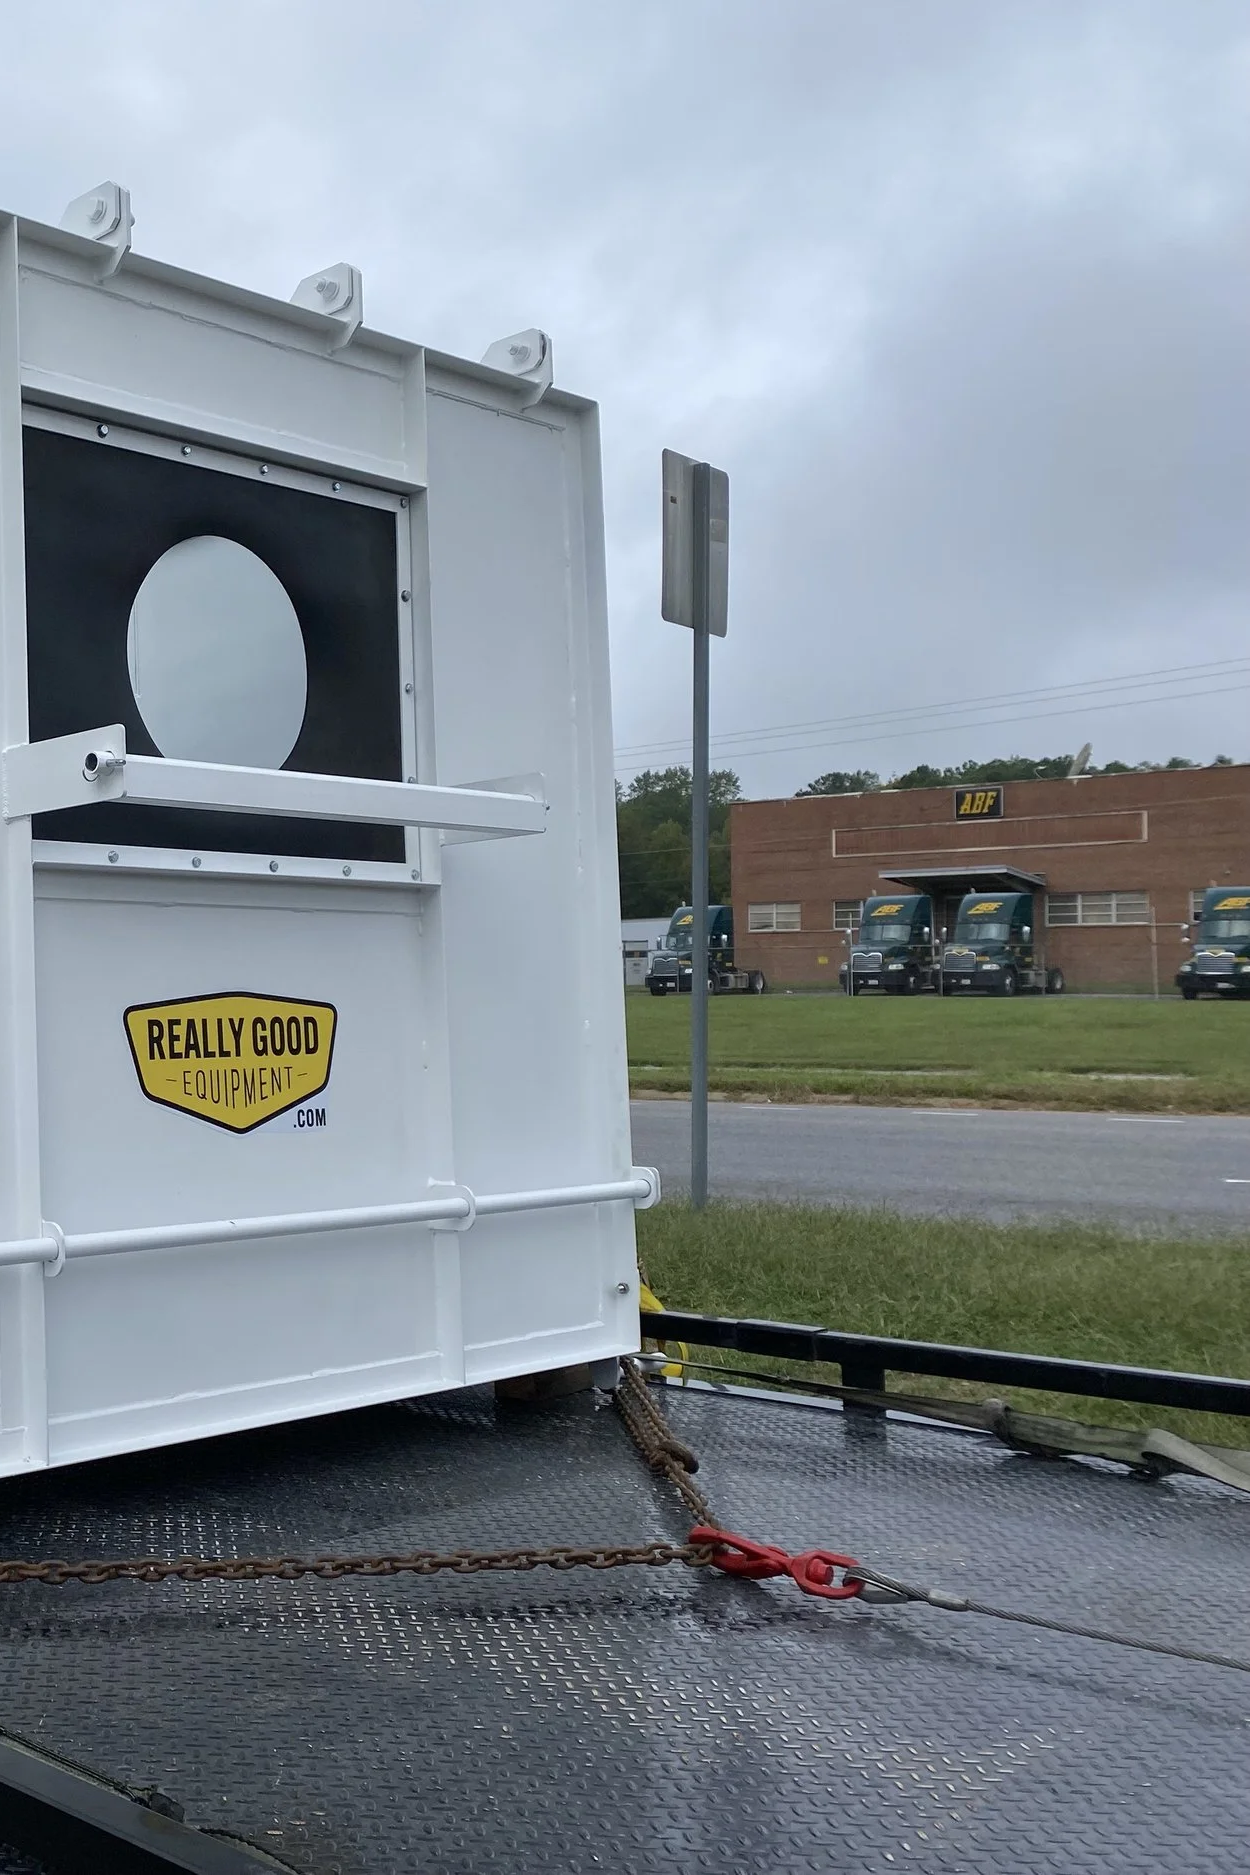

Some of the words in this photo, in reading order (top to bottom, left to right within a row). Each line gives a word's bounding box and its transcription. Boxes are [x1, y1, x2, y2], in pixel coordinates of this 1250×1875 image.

[959, 791, 998, 815] ABF
[147, 1017, 245, 1060] REALLY
[251, 1016, 319, 1056] GOOD
[183, 1066, 293, 1109] EQUIPMENT
[293, 1108, 327, 1128] .COM
